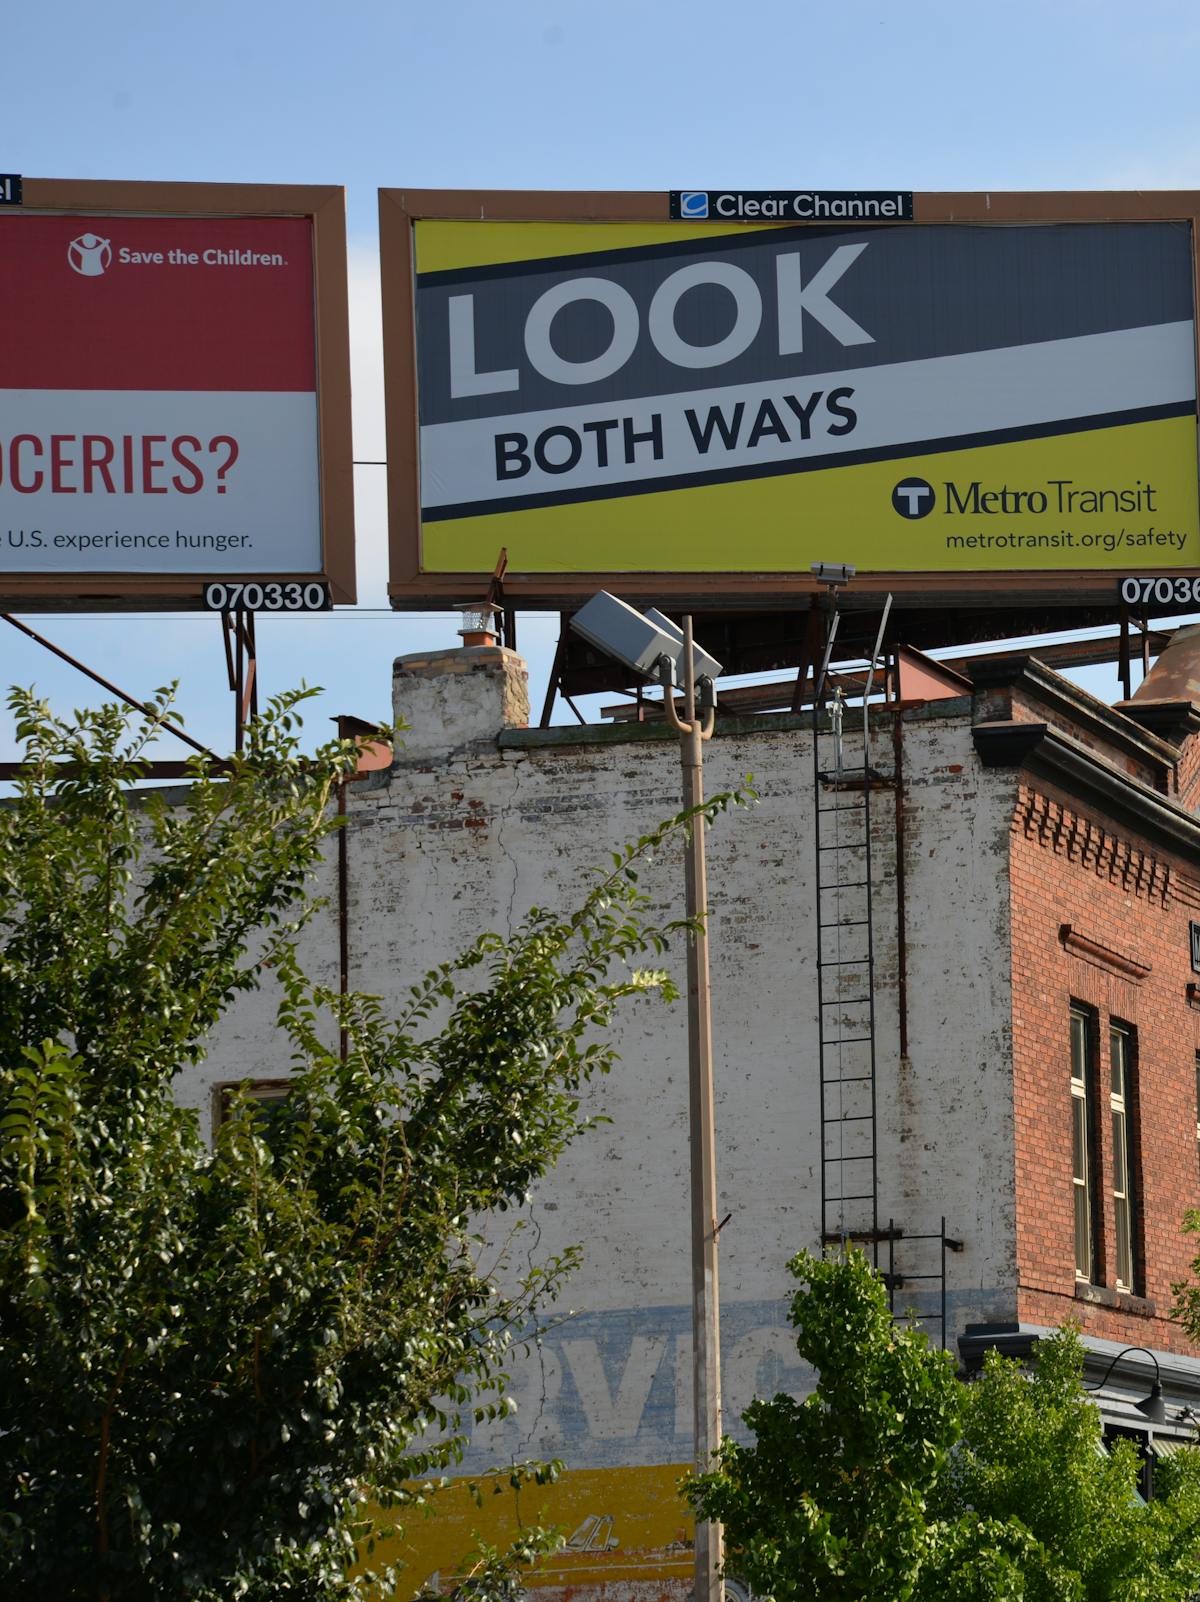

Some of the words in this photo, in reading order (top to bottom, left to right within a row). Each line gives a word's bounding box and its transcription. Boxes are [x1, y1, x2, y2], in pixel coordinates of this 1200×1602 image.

[716, 194, 788, 216] Clear
[793, 194, 903, 216] Channel
[119, 247, 164, 264] Save
[168, 248, 199, 264] the
[449, 242, 876, 398] LOOK
[495, 412, 664, 481] BOTH
[685, 387, 858, 454] WAYS
[0, 434, 239, 494] CERIES?
[8, 530, 47, 548] U.S.
[53, 530, 170, 551] experience
[175, 530, 253, 551] hunger.
[946, 528, 1188, 551] metrotransit.org/safety
[206, 583, 325, 610] 070330
